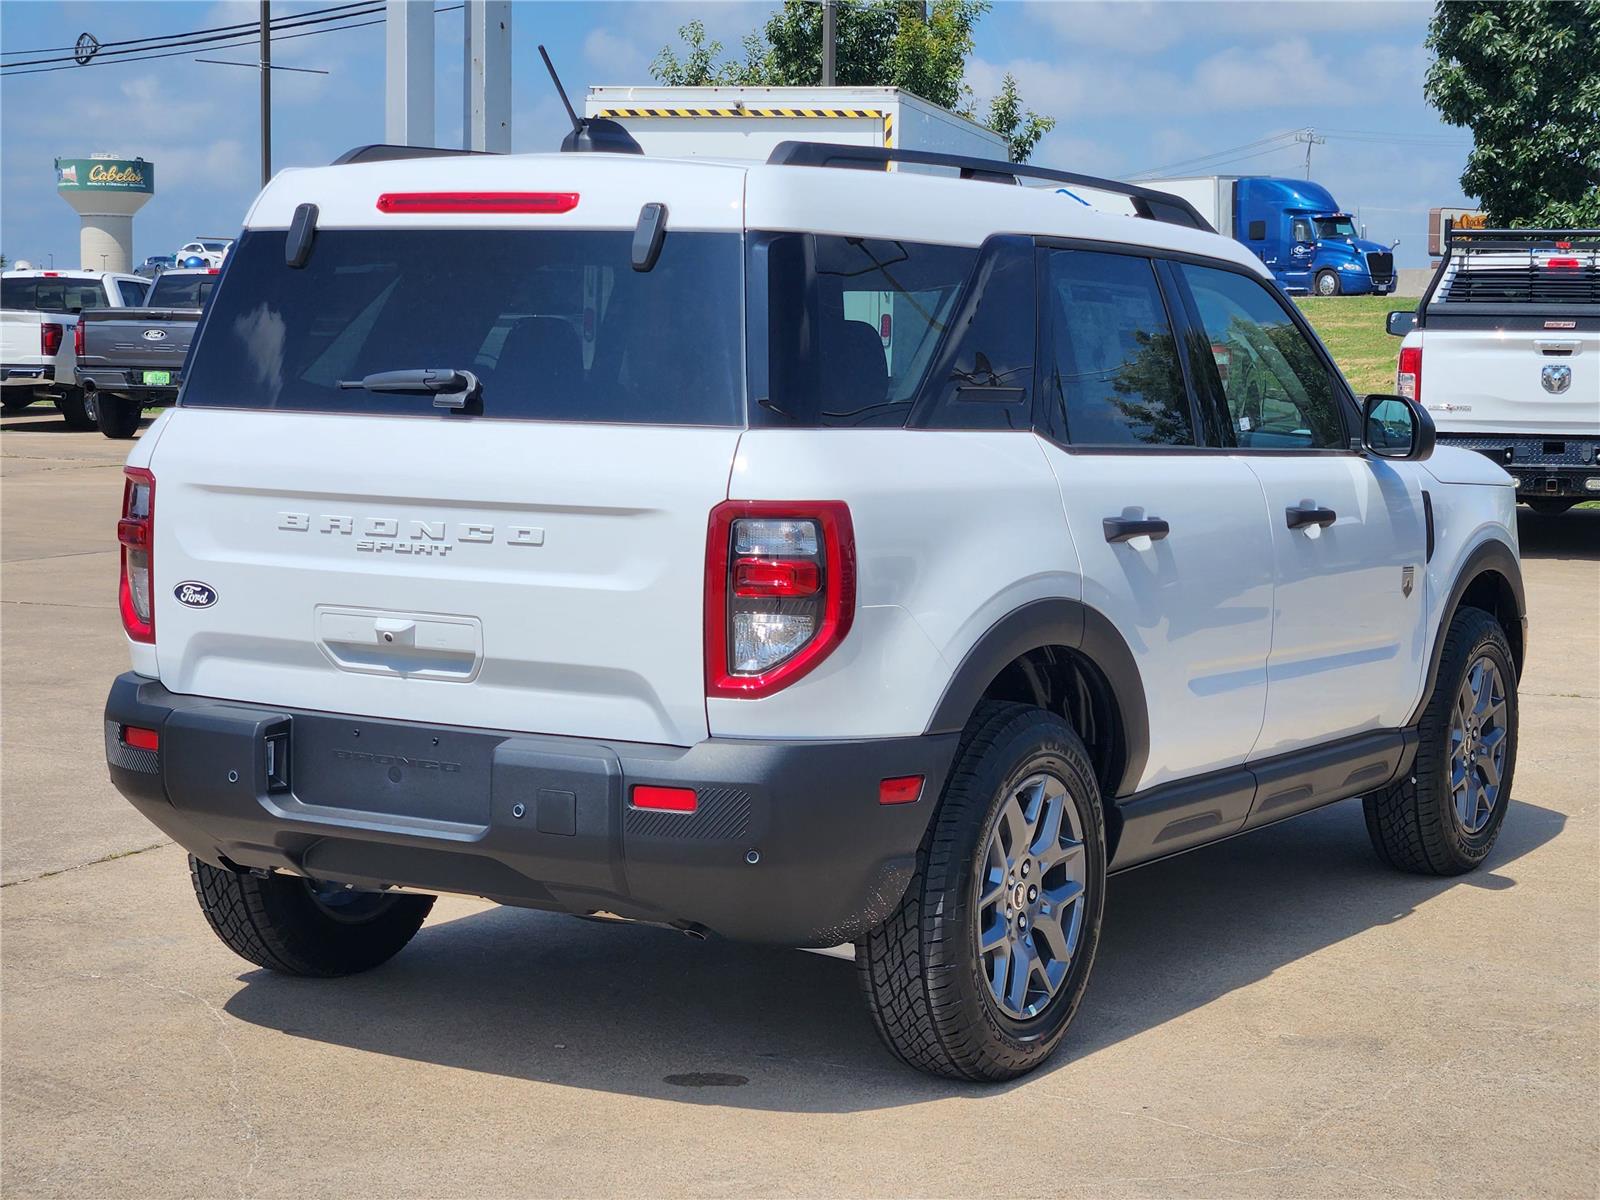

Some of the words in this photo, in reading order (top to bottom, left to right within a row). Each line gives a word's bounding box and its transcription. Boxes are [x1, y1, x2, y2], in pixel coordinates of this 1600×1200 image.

[278, 511, 545, 547] BRONCO
[357, 539, 452, 556] SPORT
[180, 585, 209, 604] Ford
[335, 750, 461, 772] BRONCO
